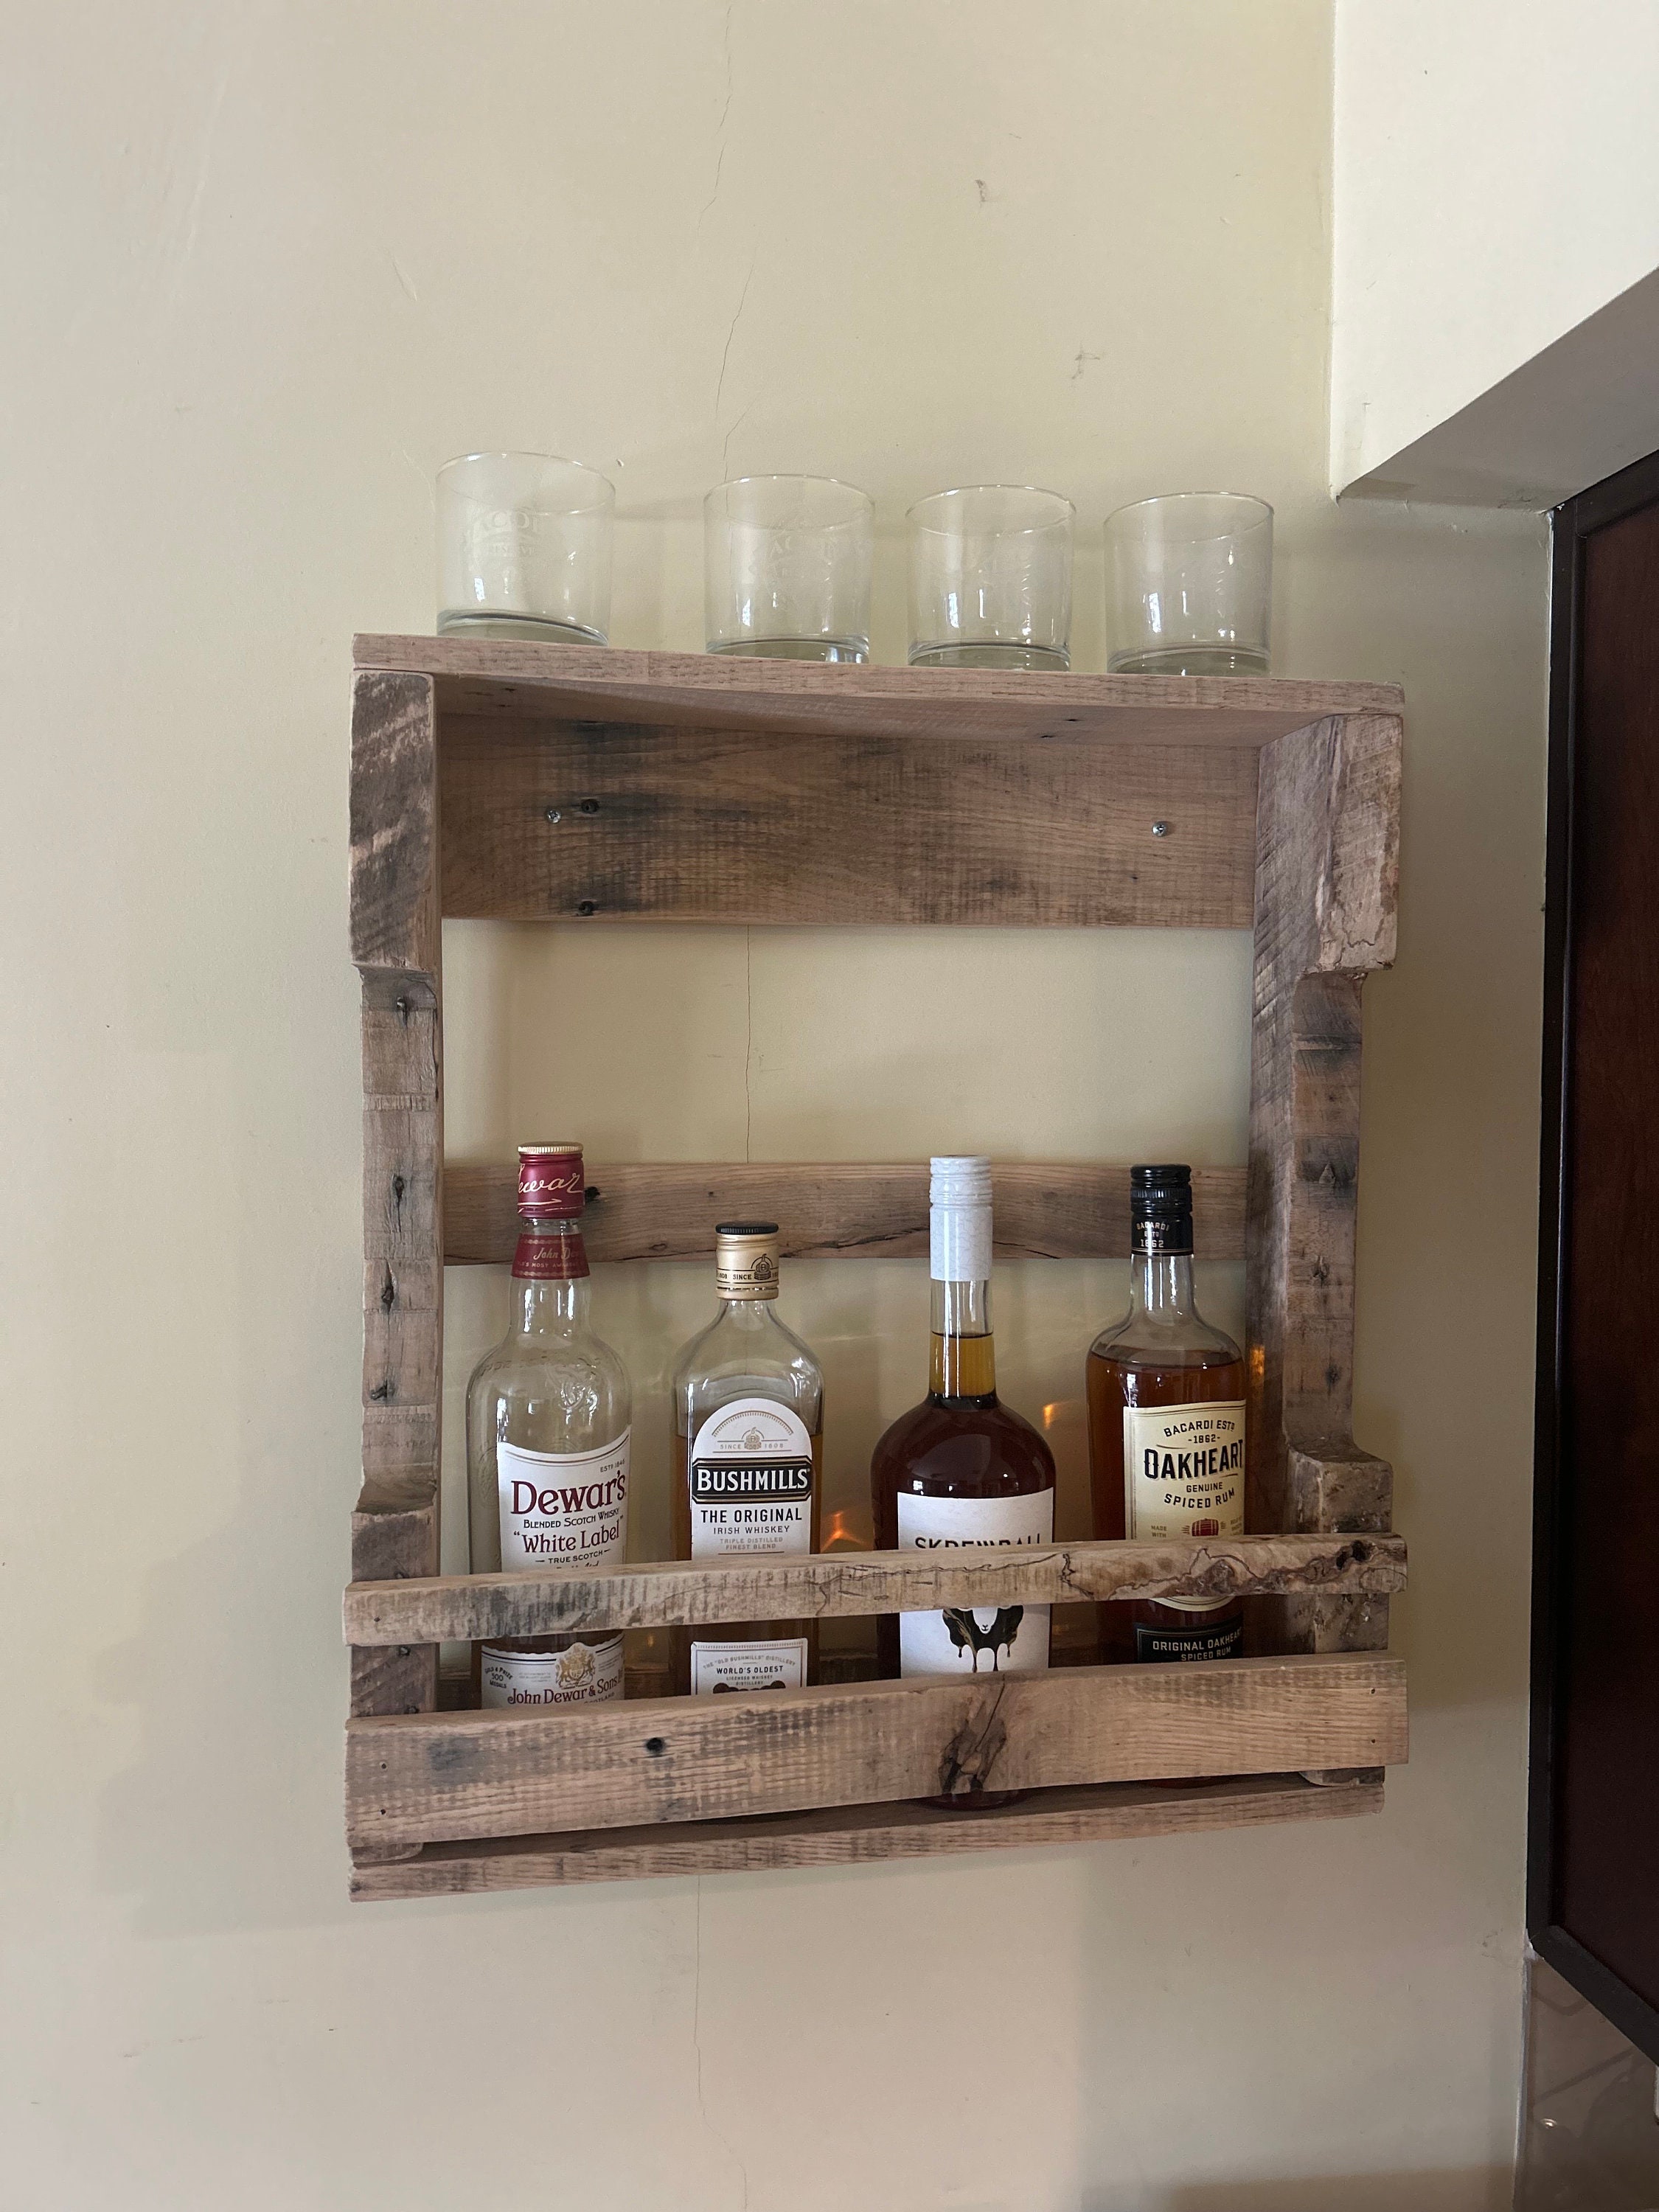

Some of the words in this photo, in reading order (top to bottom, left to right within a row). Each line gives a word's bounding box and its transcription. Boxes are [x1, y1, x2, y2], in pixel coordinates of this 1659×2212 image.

[533, 1248, 559, 1260] John
[1164, 1419, 1213, 1437] BACARDI
[1144, 1439, 1243, 1480] OAKHEART
[697, 1468, 808, 1491] BUSHMILLS
[511, 1470, 625, 1515] Dewar's
[1186, 1482, 1223, 1493] GENUINE
[1164, 1493, 1211, 1509] SPICED
[1215, 1487, 1235, 1506] RUM
[700, 1509, 727, 1523] THE
[734, 1508, 802, 1523] ORIGINAL
[745, 1525, 790, 1534] WHISKEY
[573, 1550, 603, 1562] SCOTCH
[1152, 1641, 1204, 1651] ORIGINAL
[1181, 1651, 1214, 1661] SPICED
[1217, 1646, 1231, 1658] RUM
[492, 1673, 504, 1682] 500
[507, 1688, 541, 1705] John
[543, 1688, 588, 1705] Dewar
[589, 1686, 596, 1697] &
[597, 1676, 618, 1694] Sons
